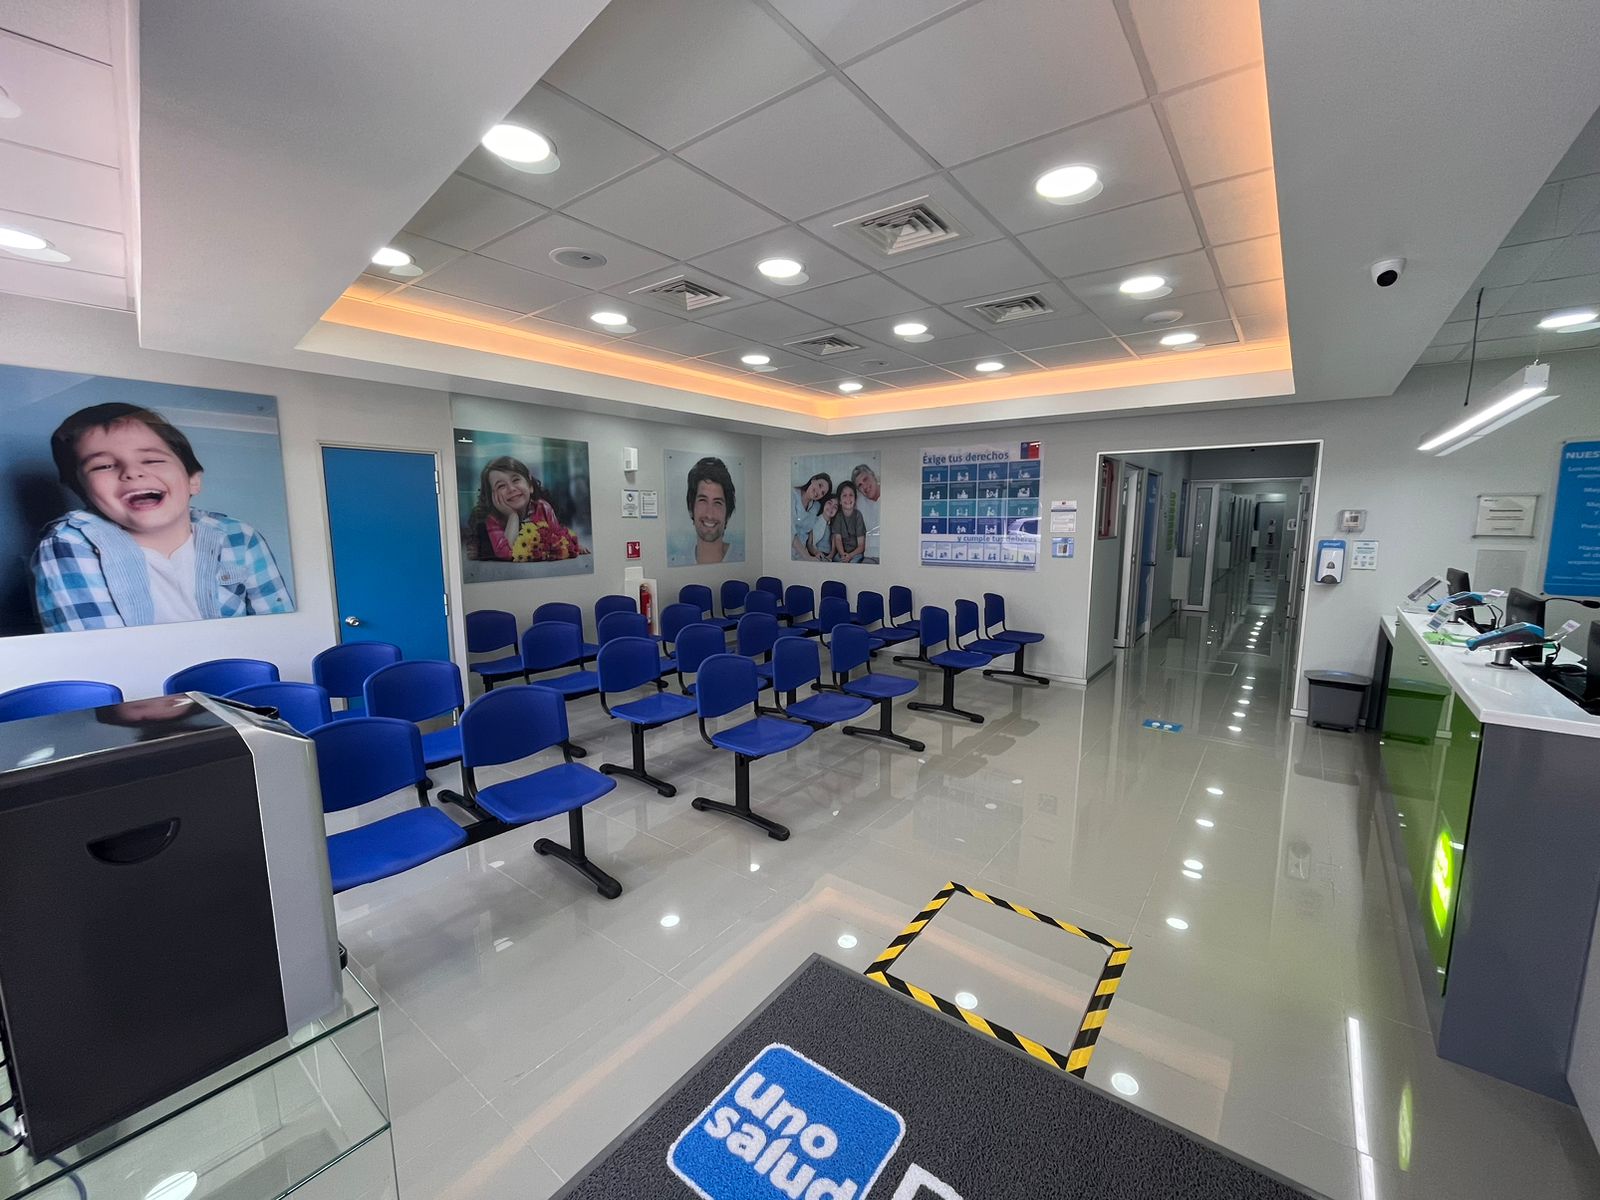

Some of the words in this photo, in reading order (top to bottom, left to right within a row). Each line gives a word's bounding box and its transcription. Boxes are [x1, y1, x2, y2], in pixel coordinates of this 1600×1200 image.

[948, 454, 964, 463] tus
[965, 451, 1009, 462] derechos
[963, 535, 991, 543] cumple
[734, 1072, 838, 1159] uno
